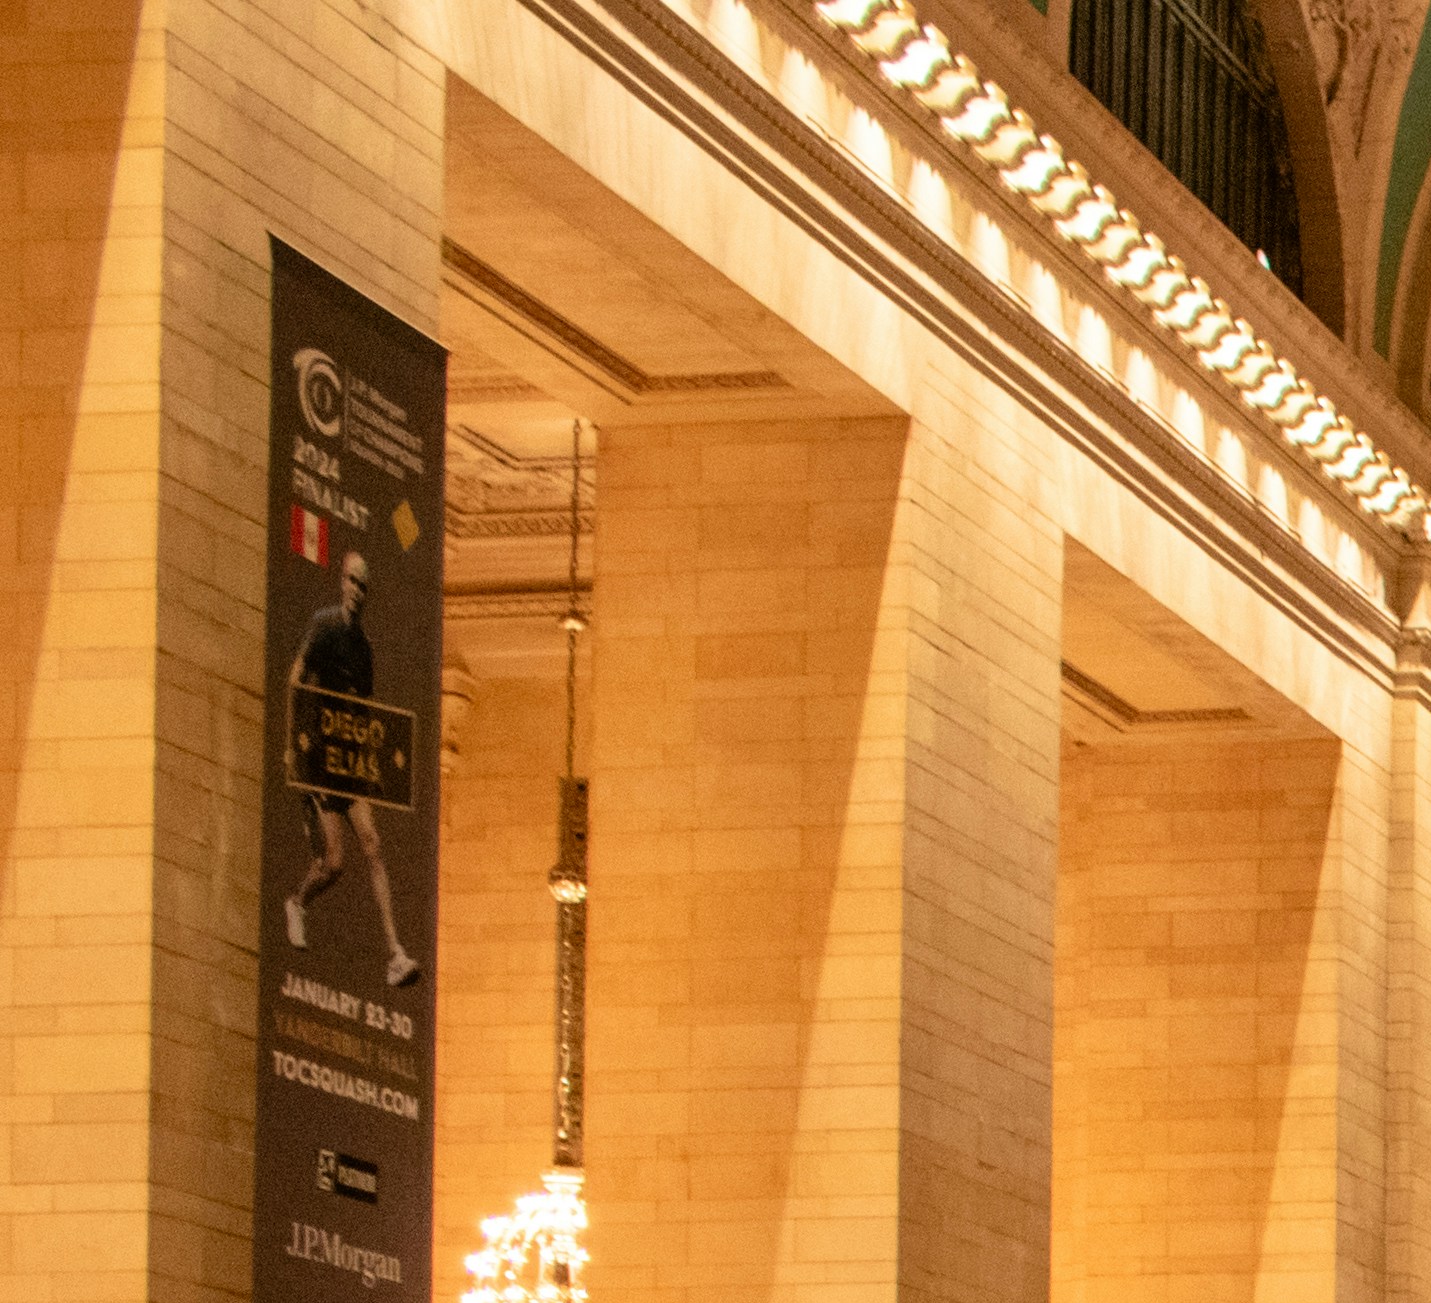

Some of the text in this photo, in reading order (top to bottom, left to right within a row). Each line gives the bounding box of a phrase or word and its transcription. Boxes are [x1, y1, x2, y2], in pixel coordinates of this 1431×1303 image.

[294, 436, 341, 482] 2024
[293, 468, 369, 531] FINALIST
[321, 708, 385, 747] DIEGO
[326, 746, 381, 782] ELIAS
[282, 972, 412, 1040] JANUARY 23-30
[273, 1051, 419, 1120] TOCSQUASH.COM
[286, 1222, 402, 1288] J.P.Morgan
